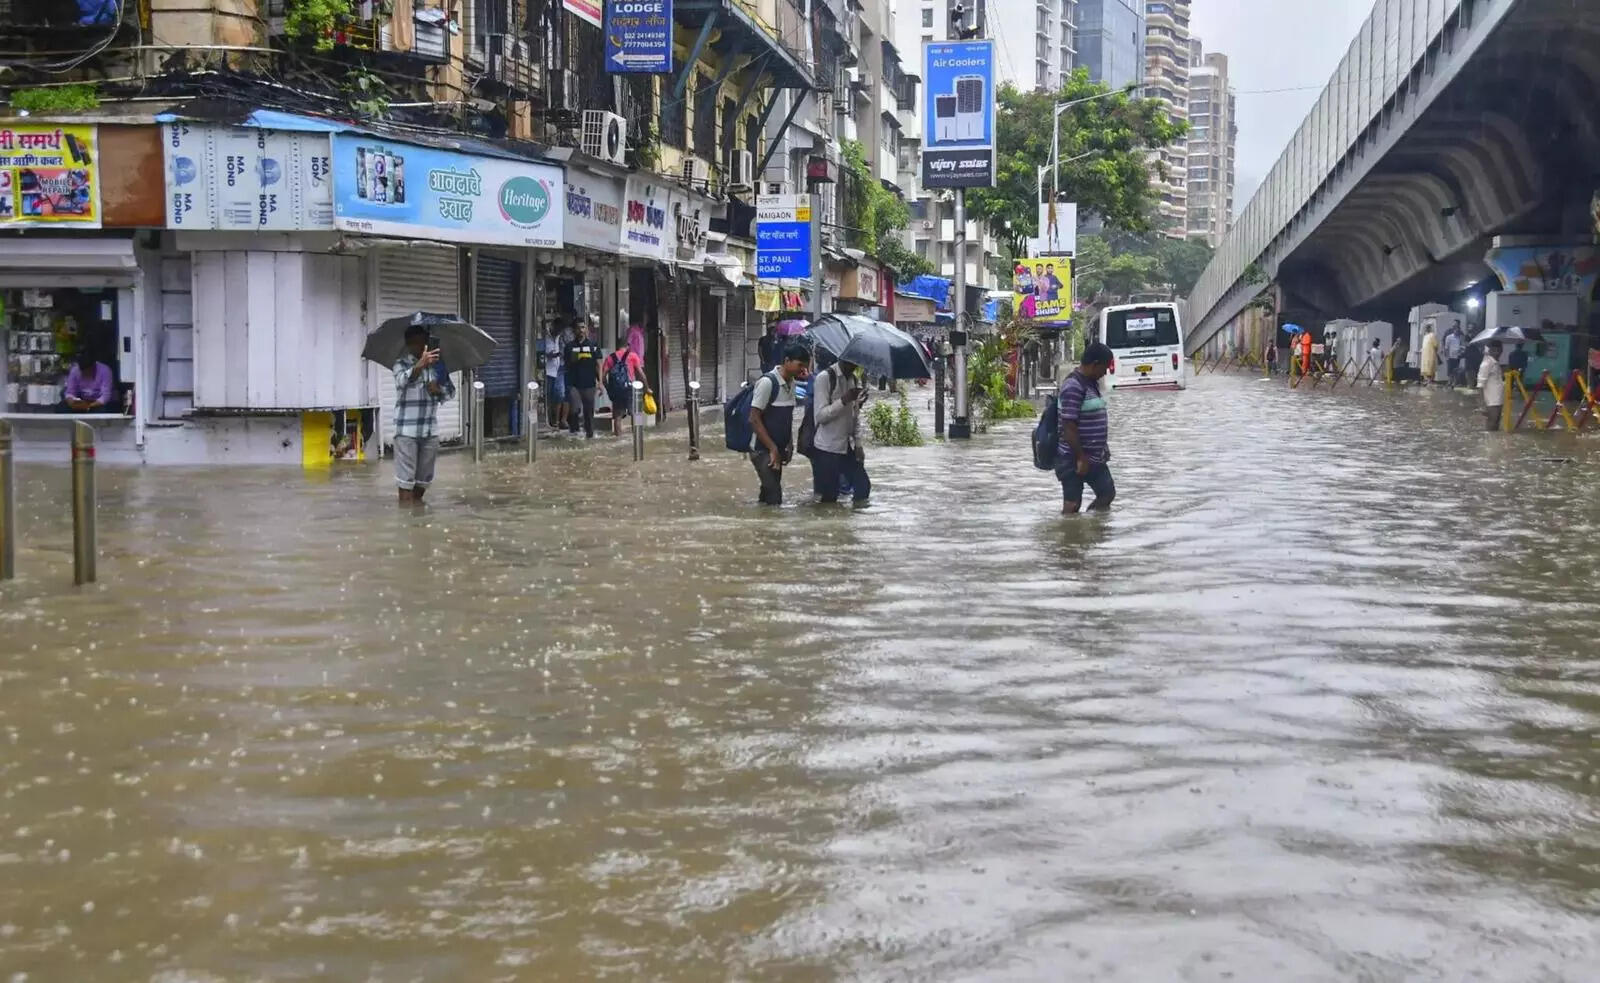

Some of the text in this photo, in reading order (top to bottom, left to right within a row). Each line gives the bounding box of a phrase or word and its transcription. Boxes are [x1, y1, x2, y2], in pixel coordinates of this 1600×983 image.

[615, 3, 663, 13] LODGE
[933, 57, 986, 68] Air Coolers
[227, 156, 235, 187] BOND
[237, 156, 244, 174] MA
[321, 156, 329, 175] MA
[930, 158, 988, 171] vijay sales
[174, 193, 182, 224] BOND
[184, 194, 192, 212] MA
[269, 194, 276, 212] MA
[504, 188, 546, 212] Heritage
[260, 194, 268, 225] BOND
[439, 198, 473, 222] स्वाद
[758, 211, 792, 220] NAIGAON
[1035, 298, 1066, 310] GAME
[1035, 307, 1060, 316] SHURU
